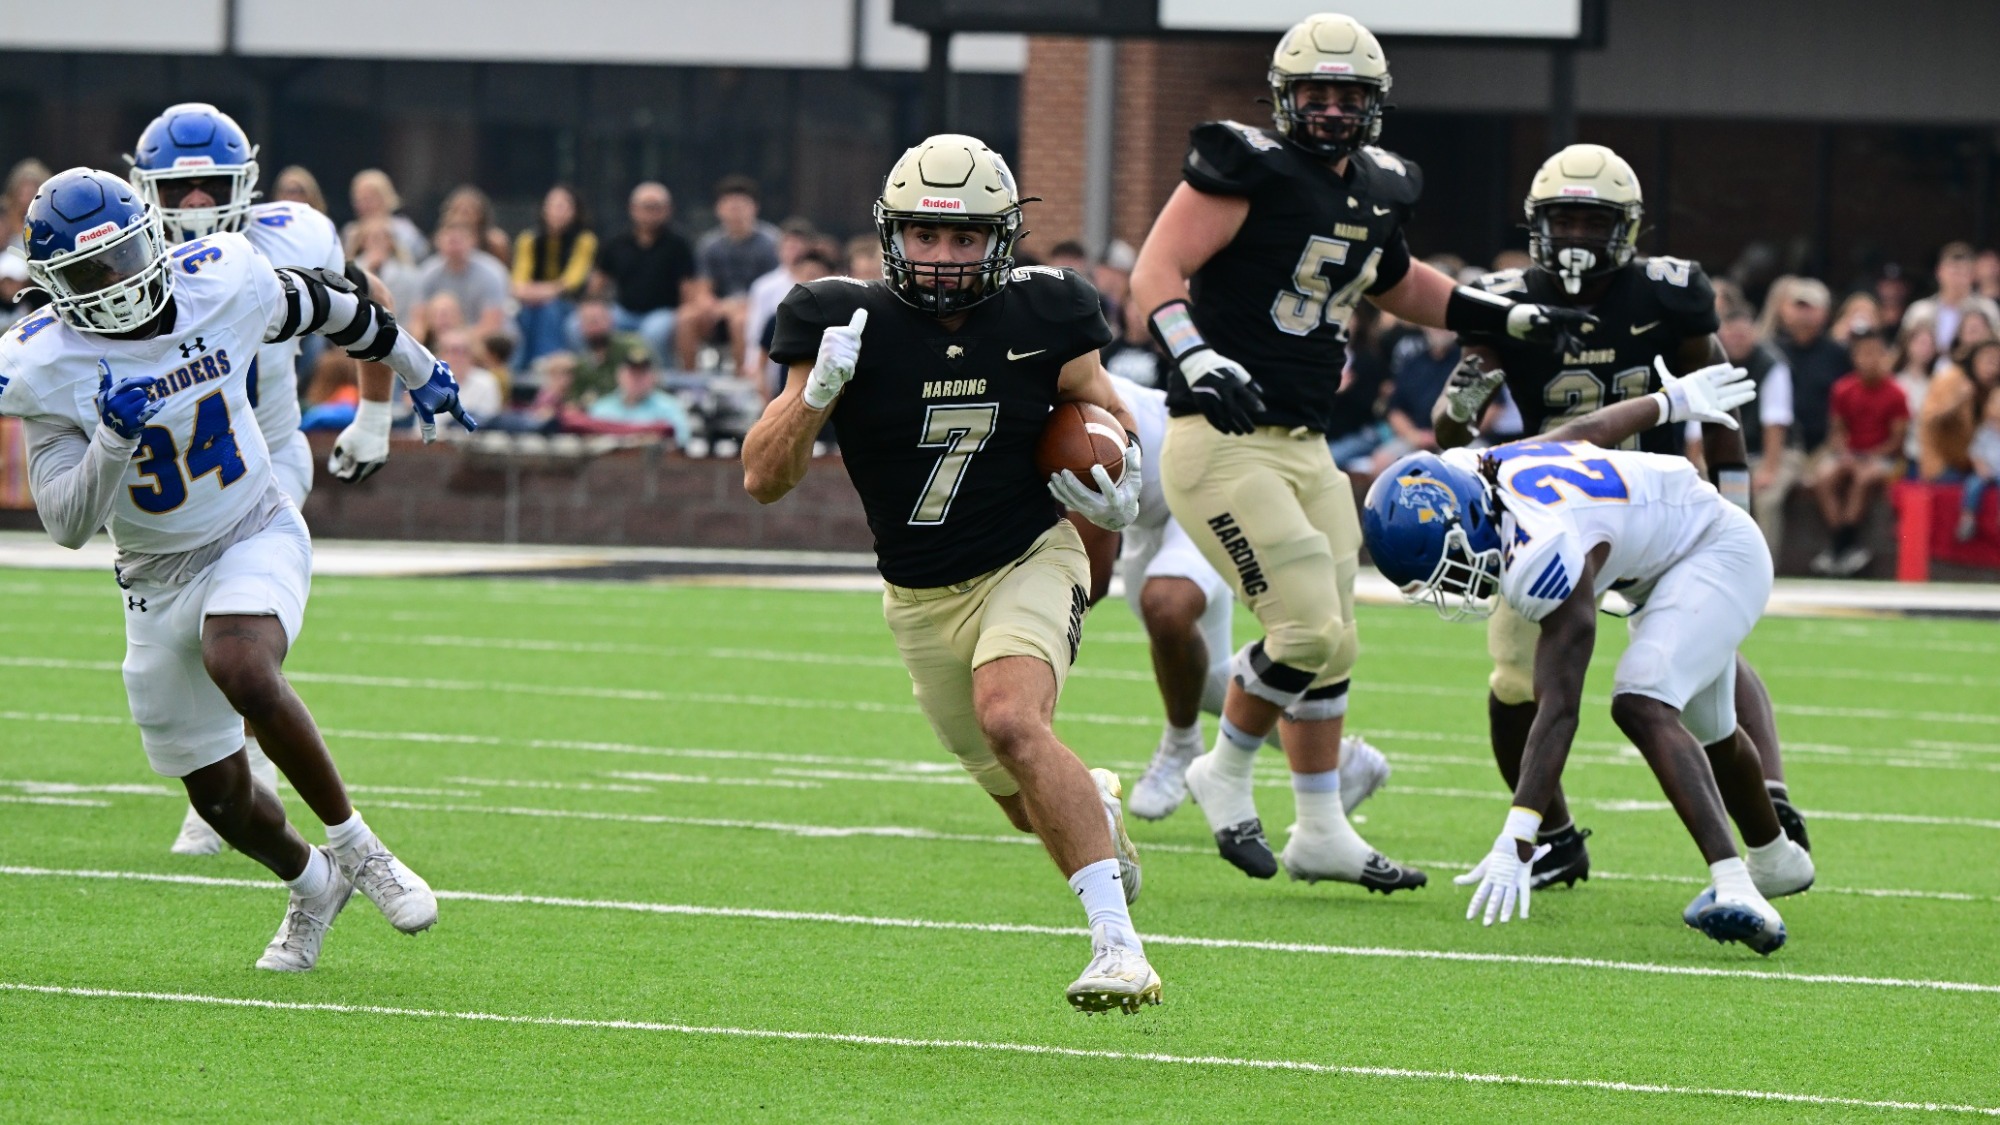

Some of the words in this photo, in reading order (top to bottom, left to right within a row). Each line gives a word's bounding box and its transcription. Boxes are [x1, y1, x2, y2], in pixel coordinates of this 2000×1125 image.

[80, 225, 114, 243] Riddell
[922, 199, 960, 209] Riddell
[1269, 234, 1383, 342] 54
[922, 378, 987, 399] HARDING
[128, 388, 248, 515] 34
[907, 402, 1000, 526] 7
[1207, 512, 1269, 597] HARDING
